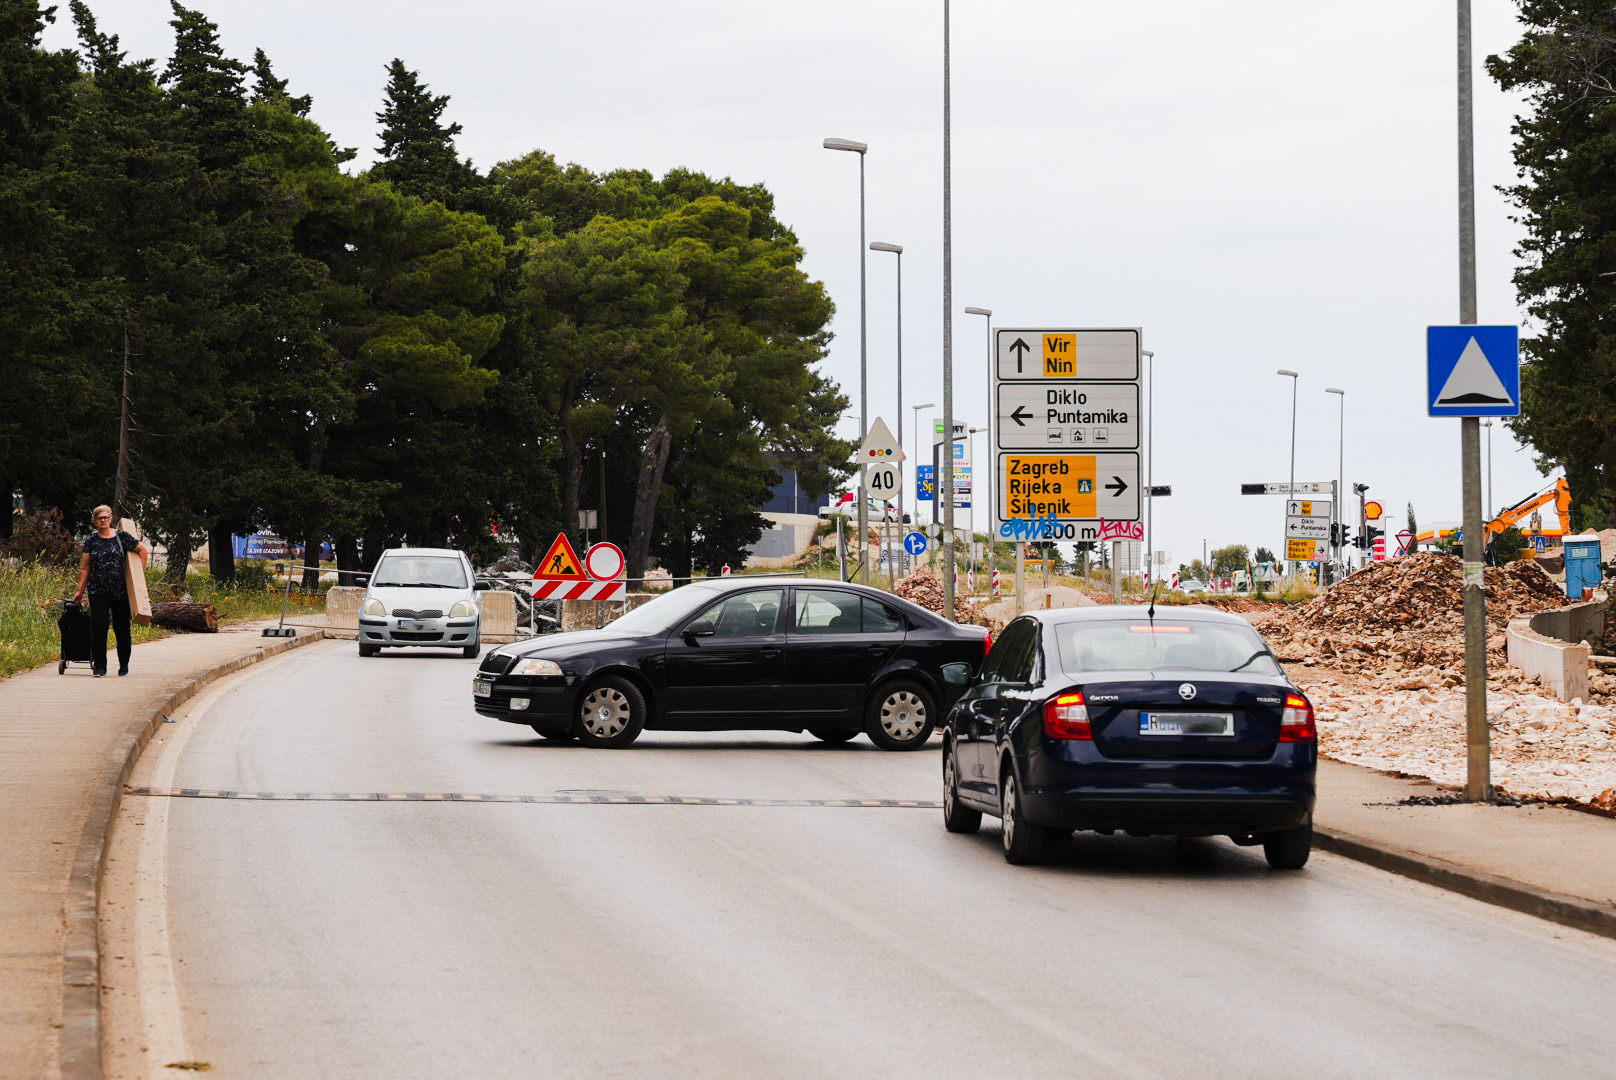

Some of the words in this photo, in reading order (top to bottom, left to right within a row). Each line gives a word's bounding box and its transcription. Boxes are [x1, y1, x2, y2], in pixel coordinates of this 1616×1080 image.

[1047, 338, 1070, 352] Vir
[1047, 358, 1072, 372] Nin
[1047, 389, 1087, 405] Diklo
[1047, 409, 1128, 424] Puntamika
[1010, 459, 1069, 479] Zagreb
[872, 471, 893, 489] 40
[1010, 478, 1062, 498] Rijeka
[1010, 494, 1071, 514] Šibenik
[1517, 501, 1539, 516] HYUNDAI
[1042, 524, 1075, 539] 200
[1081, 527, 1096, 539] m
